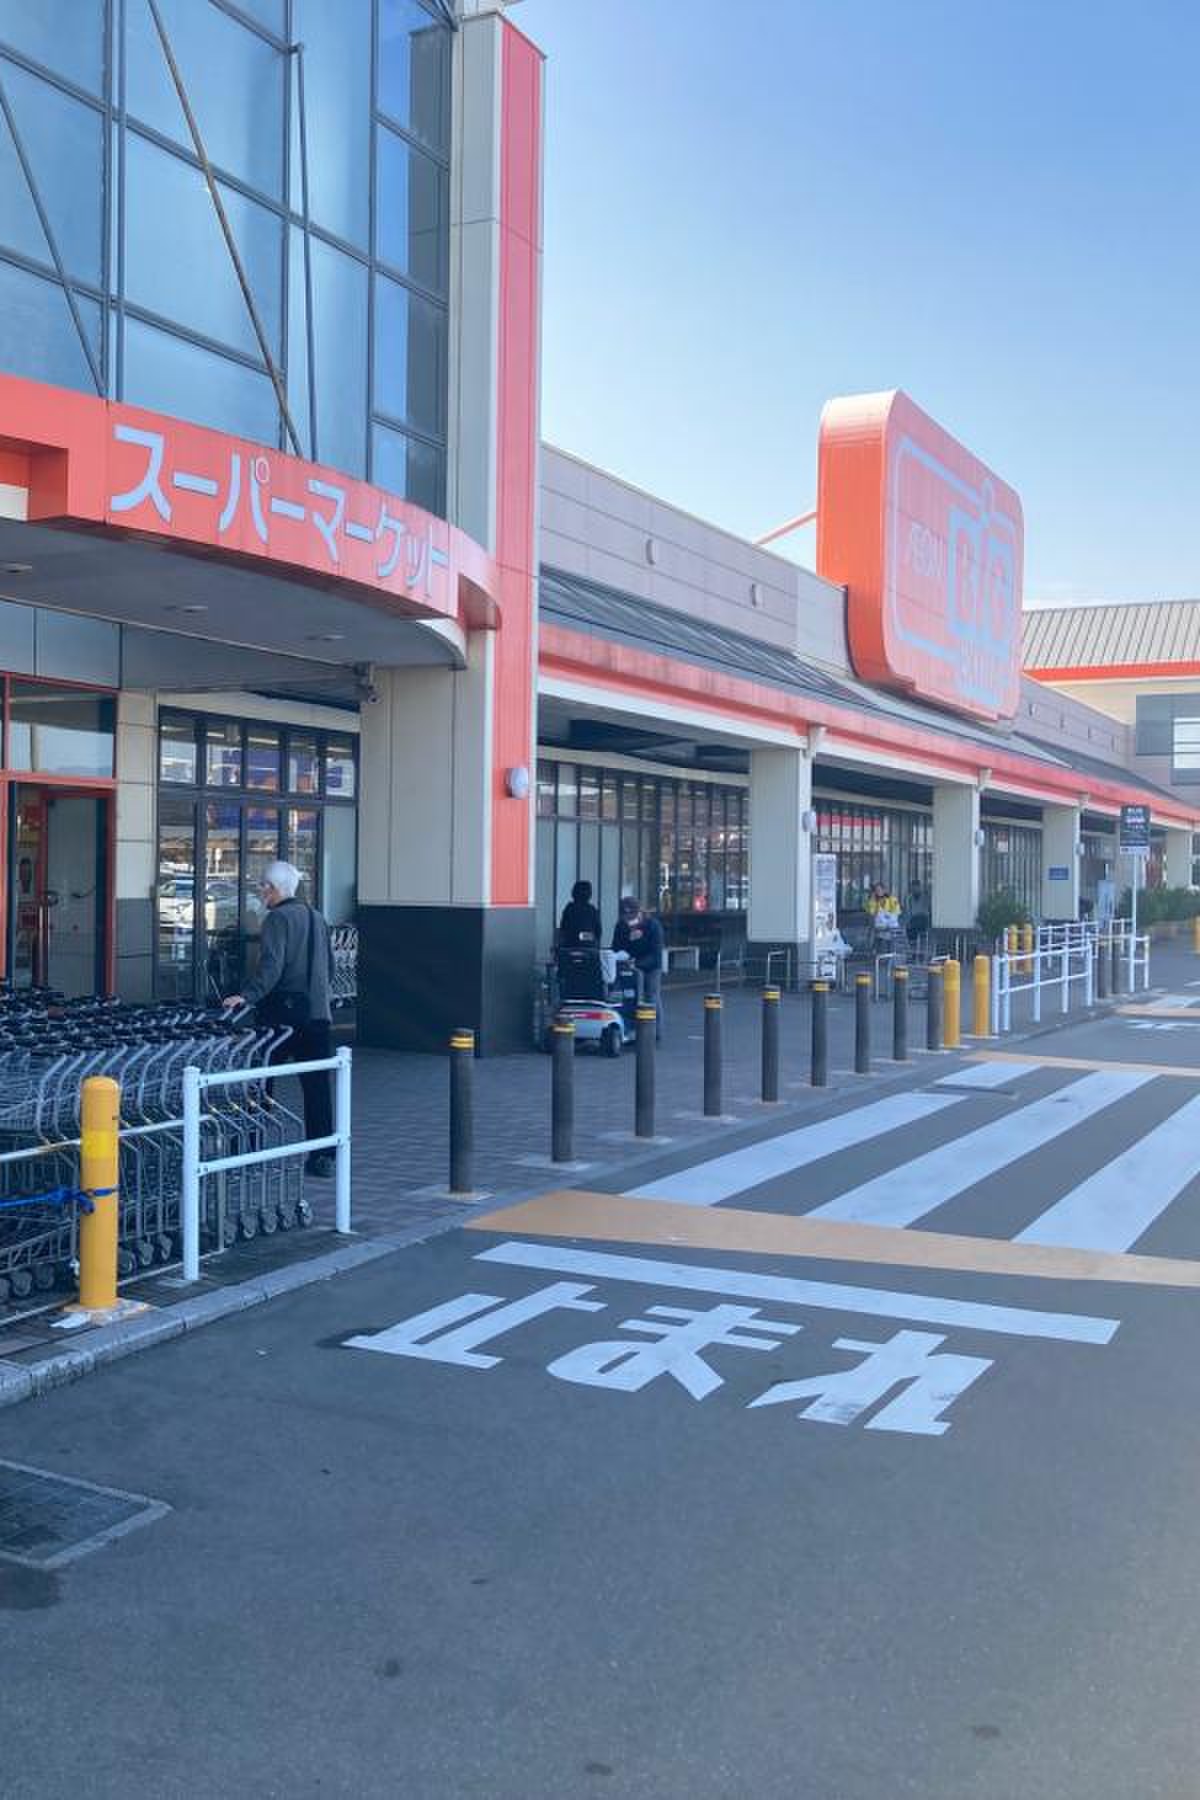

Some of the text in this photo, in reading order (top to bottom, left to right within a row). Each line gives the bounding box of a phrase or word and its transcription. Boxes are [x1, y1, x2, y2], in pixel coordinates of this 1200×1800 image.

[110, 424, 450, 598] スーパーマーケット
[341, 1281, 996, 1436] 止まれ
